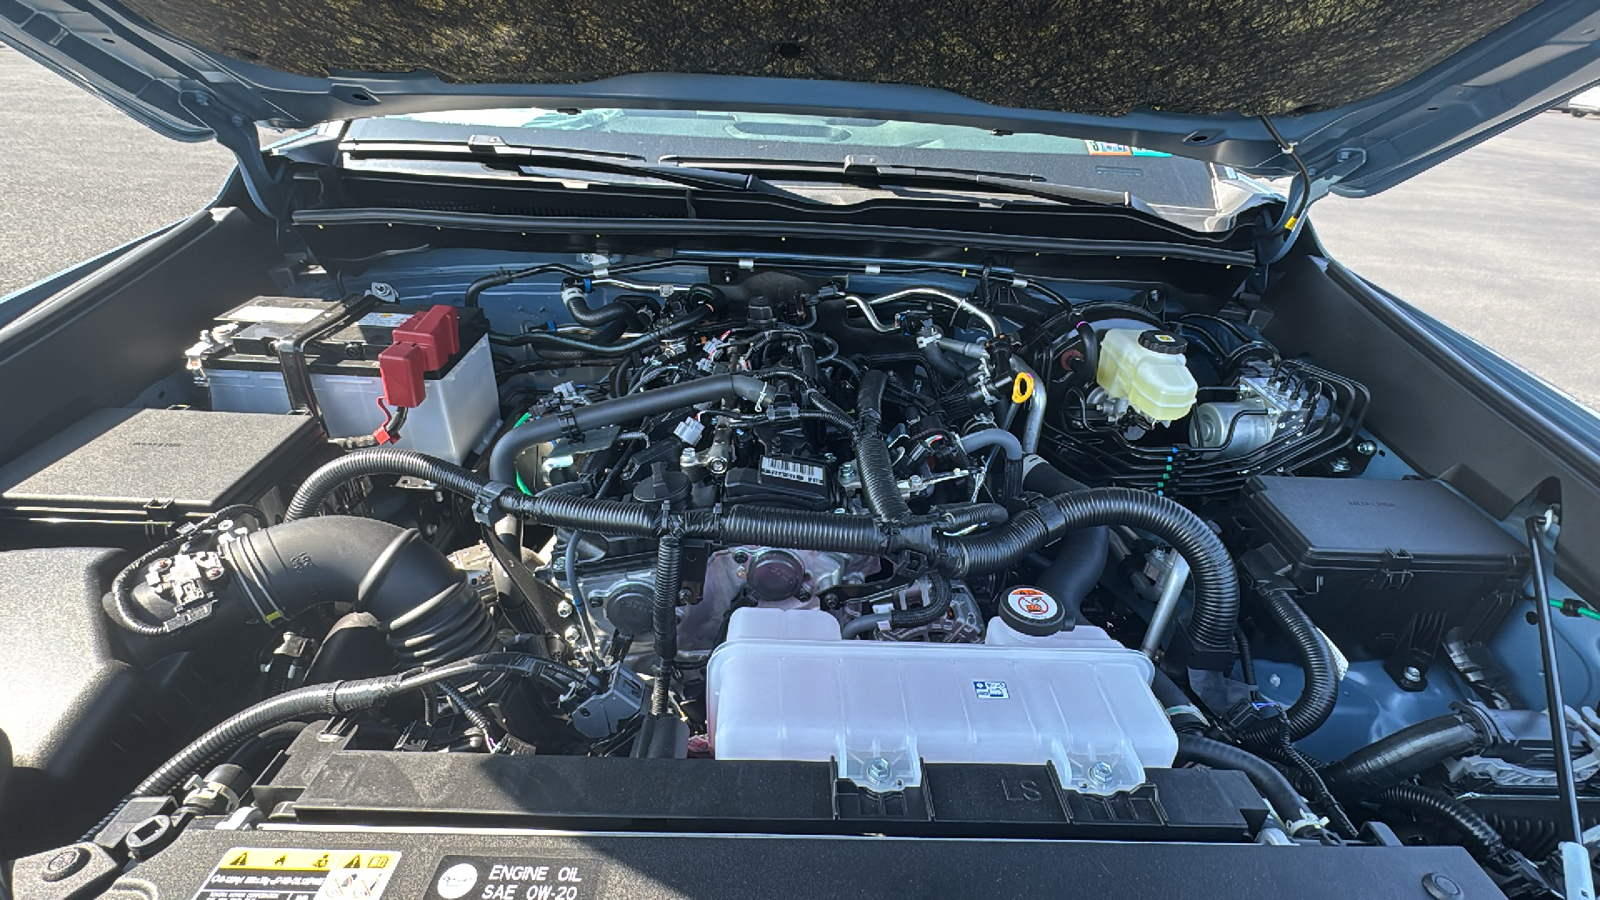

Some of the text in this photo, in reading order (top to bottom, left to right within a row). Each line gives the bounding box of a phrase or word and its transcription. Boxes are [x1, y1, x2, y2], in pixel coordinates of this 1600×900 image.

[1001, 779, 1042, 801] LS
[488, 864, 583, 882] ENGINE OIL
[481, 884, 578, 900] SAE 0W-20
